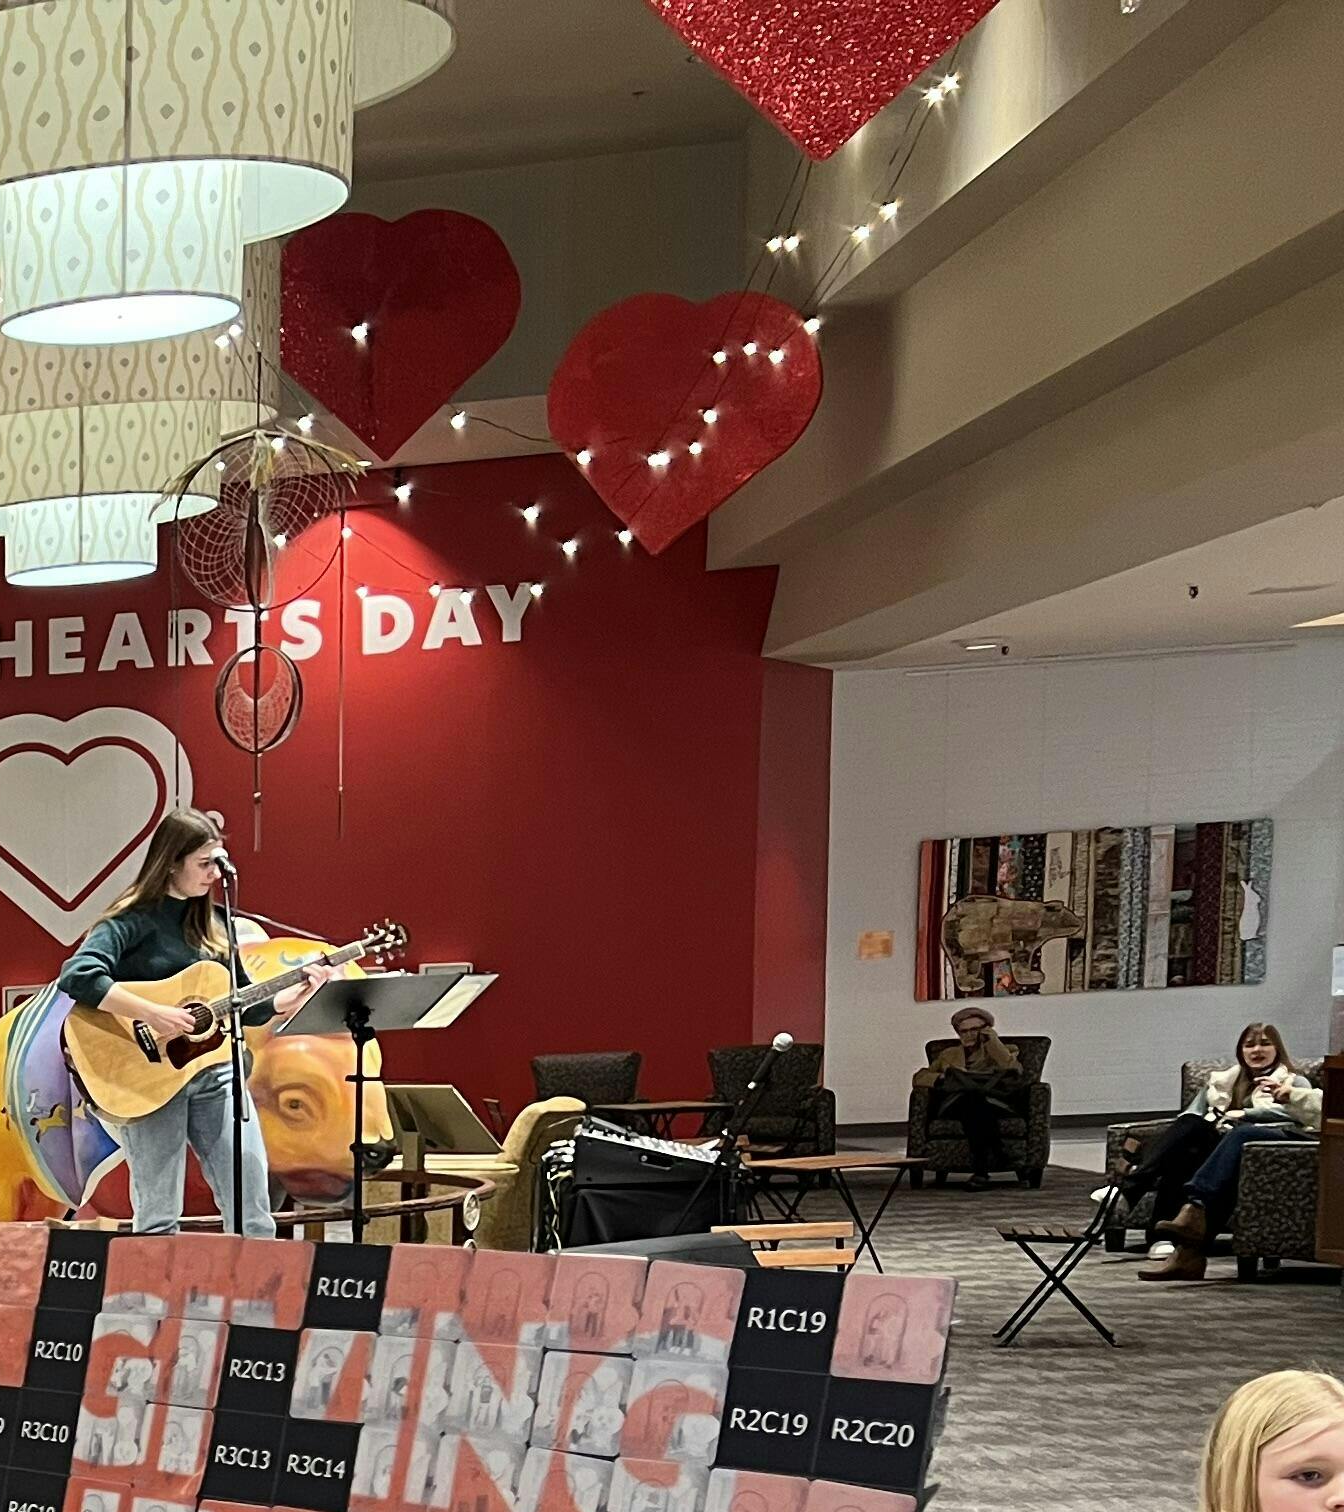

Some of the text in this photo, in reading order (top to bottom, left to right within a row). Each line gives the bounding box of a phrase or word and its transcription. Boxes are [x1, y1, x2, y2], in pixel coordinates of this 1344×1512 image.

[360, 583, 534, 656] DAY
[47, 1259, 97, 1281] R1C10
[316, 1276, 377, 1300] R1C14
[747, 1306, 827, 1334] R1C19
[34, 1340, 83, 1362] R2C10
[229, 1358, 286, 1382] R2C13
[20, 1420, 69, 1444] R3C10
[729, 1407, 915, 1448] R2C19 R2C20
[214, 1444, 346, 1480] R3C13 R3C14
